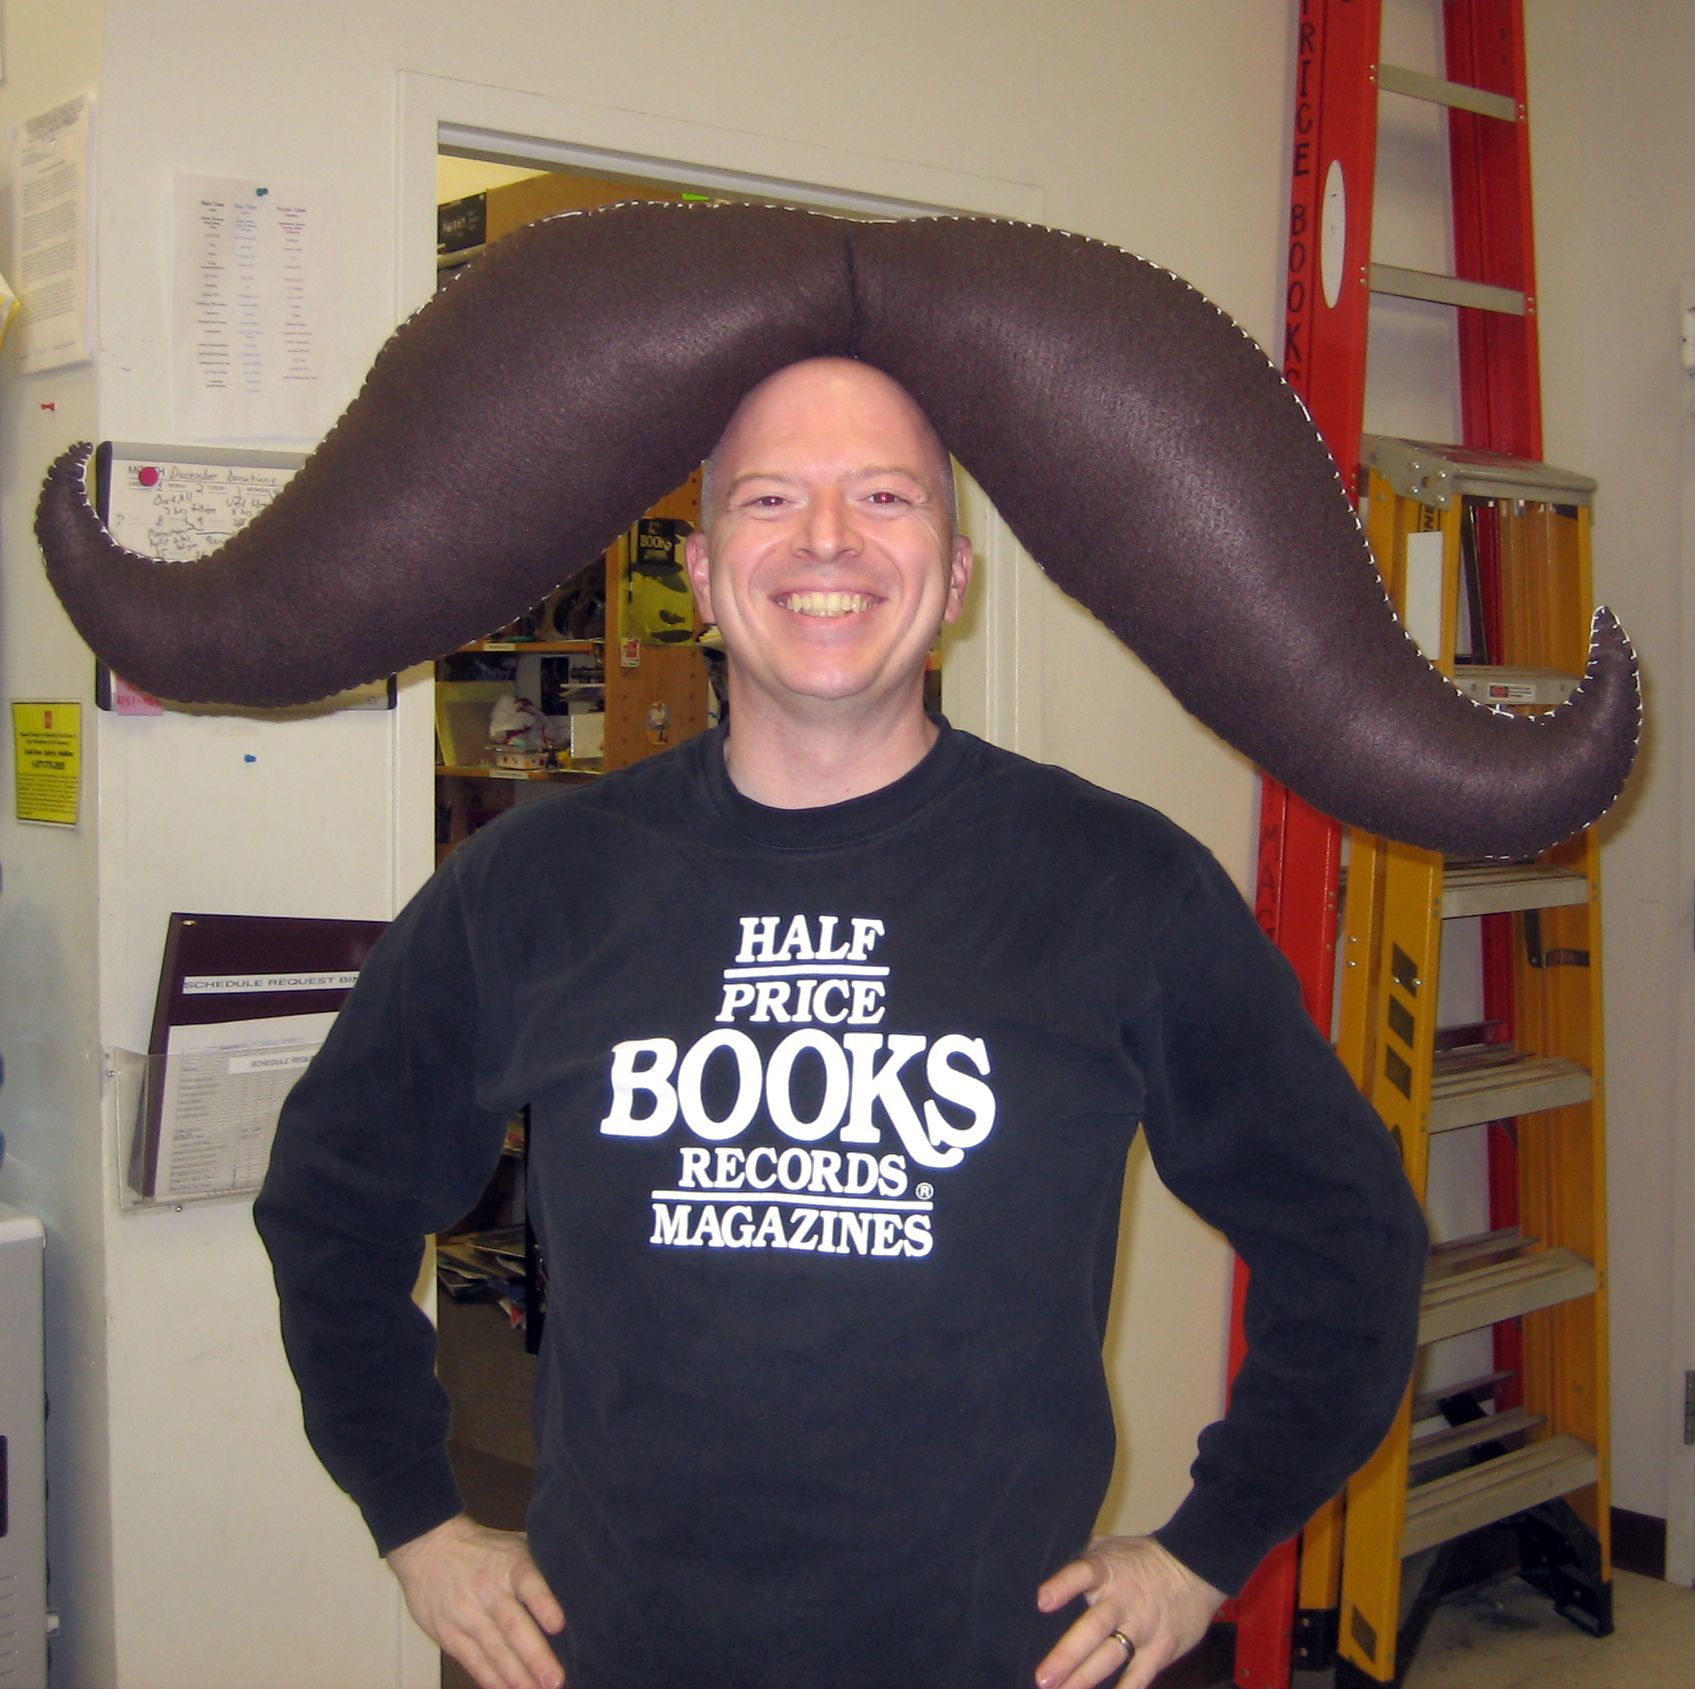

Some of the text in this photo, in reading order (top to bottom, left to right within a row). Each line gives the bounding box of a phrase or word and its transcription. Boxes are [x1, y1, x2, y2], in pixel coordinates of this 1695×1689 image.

[169, 465, 217, 479] December
[735, 914, 885, 963] HALF
[184, 979, 263, 990] SCHEDULE
[268, 977, 335, 986] REQUEST
[715, 979, 886, 1025] PRICE
[600, 1027, 996, 1168] BOOKS
[678, 1146, 909, 1197] RECORDS
[649, 1202, 934, 1257] MAGAZINES
